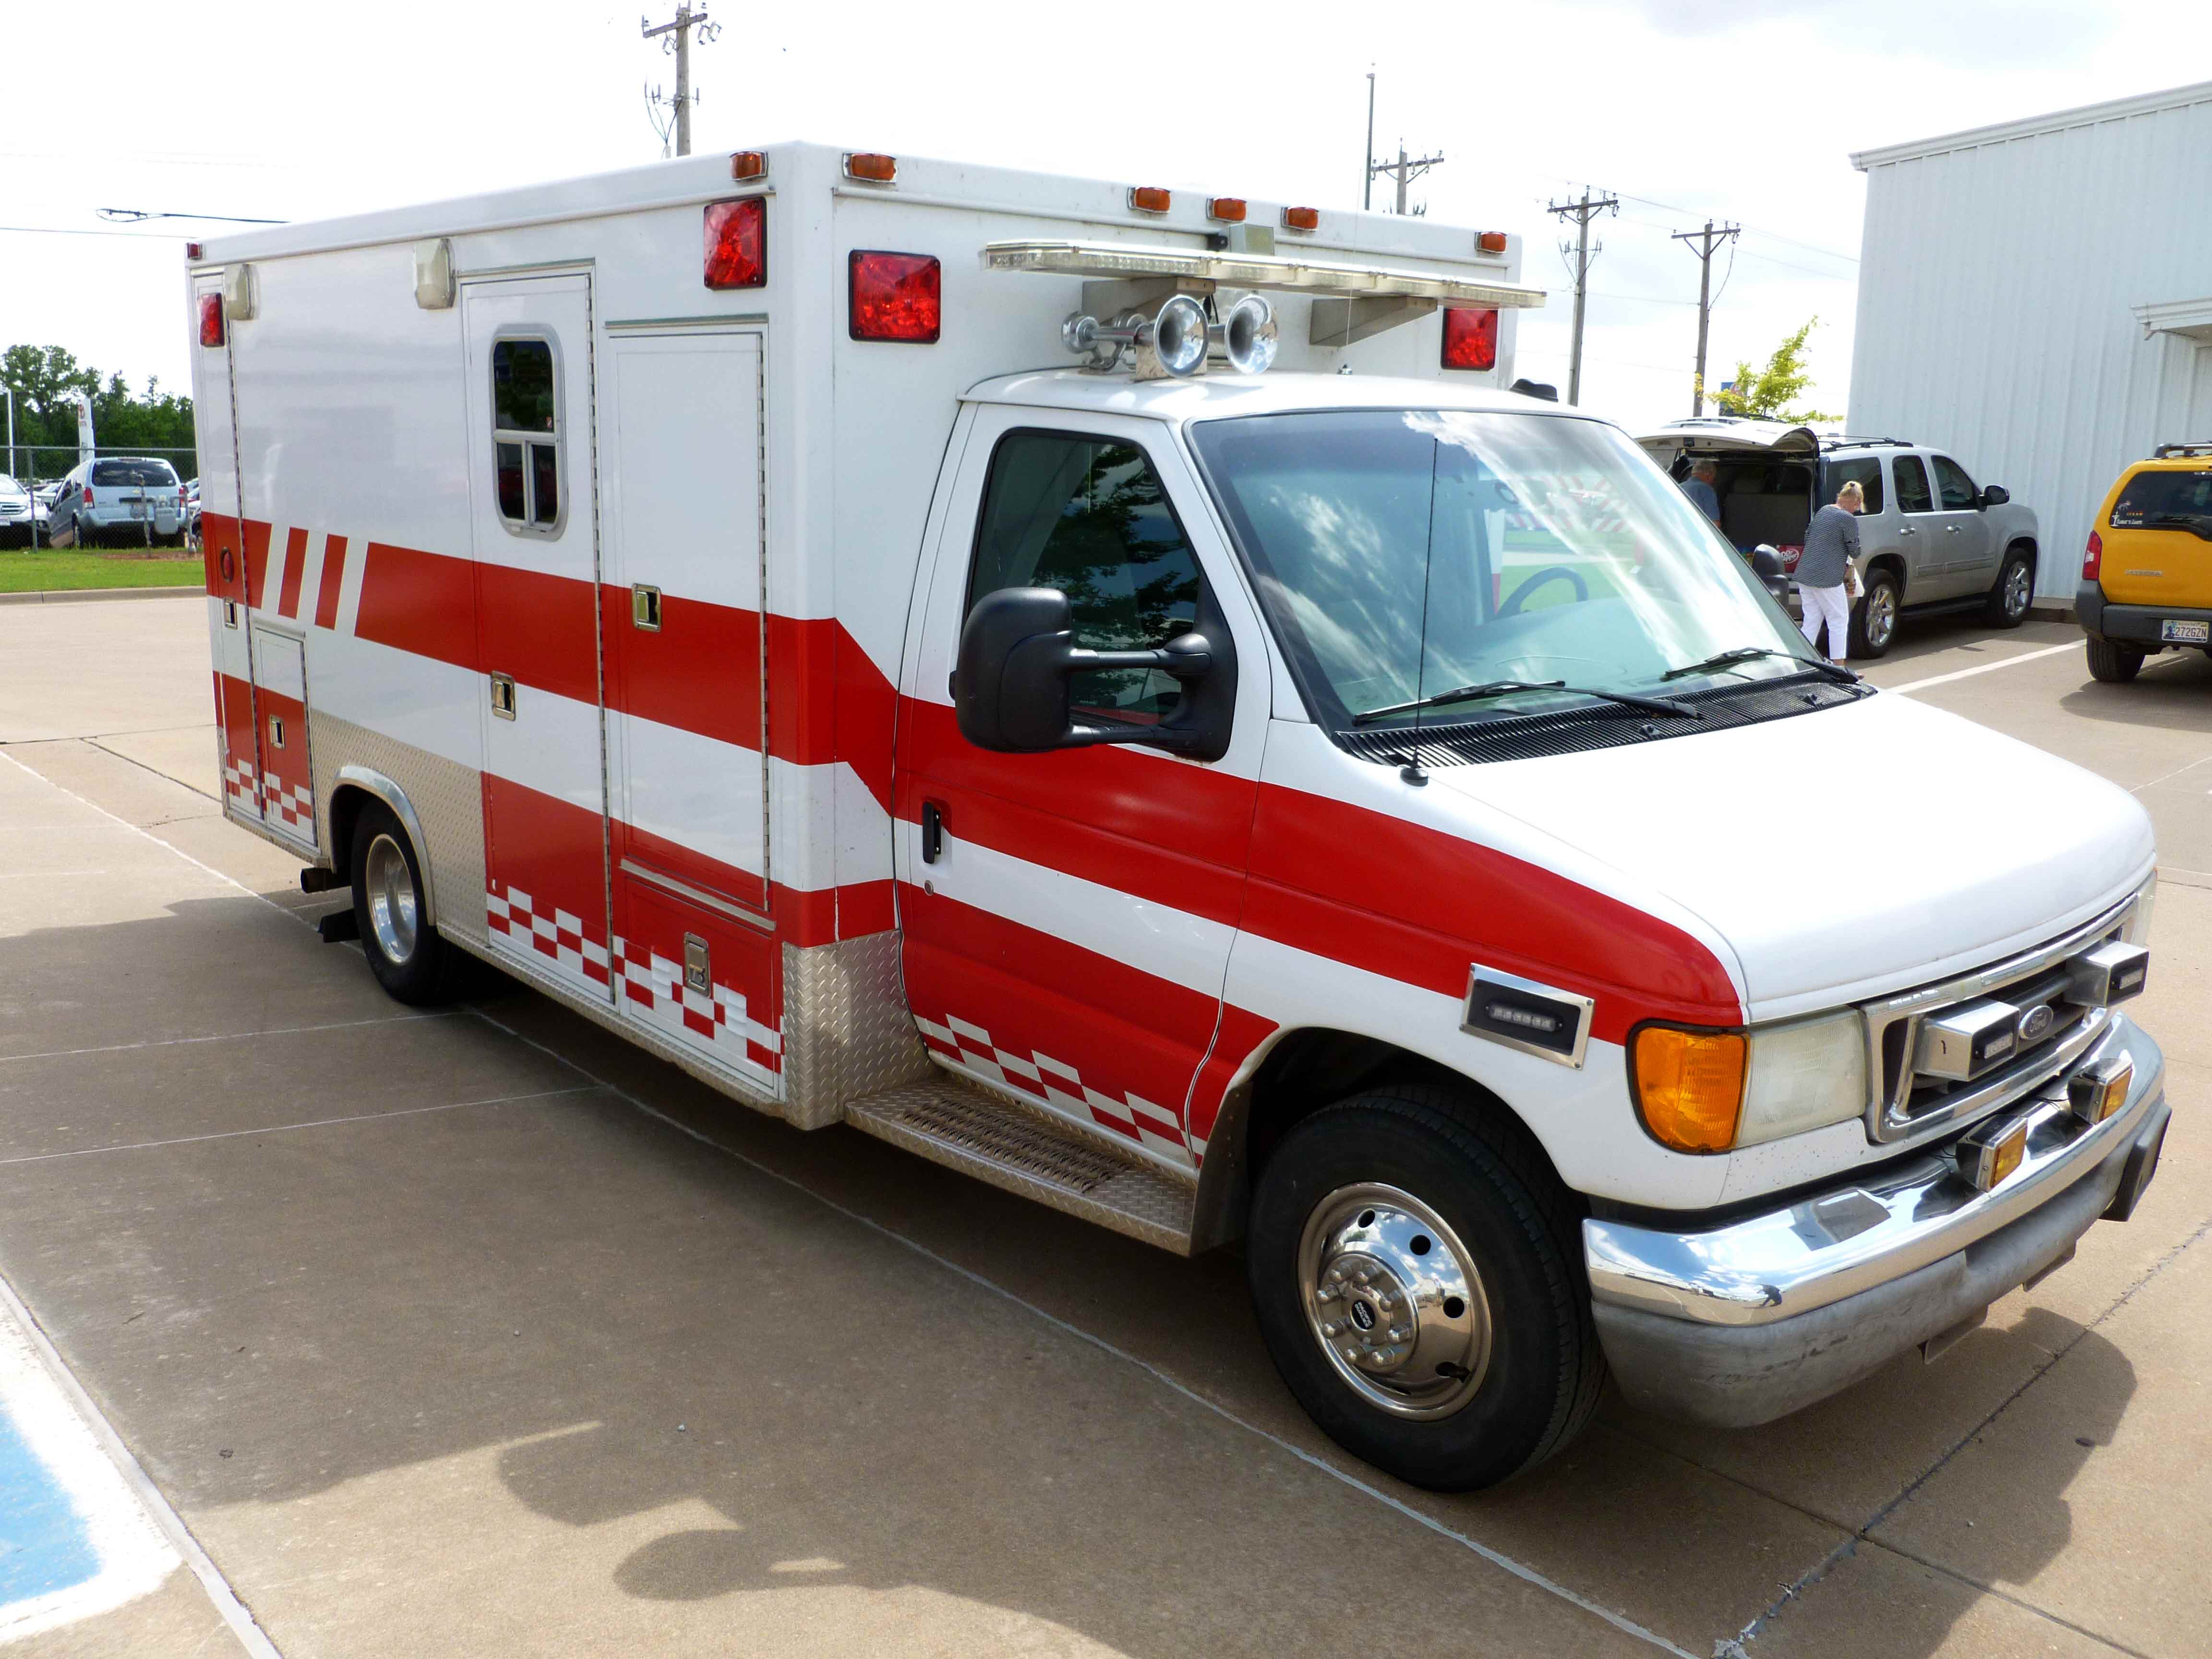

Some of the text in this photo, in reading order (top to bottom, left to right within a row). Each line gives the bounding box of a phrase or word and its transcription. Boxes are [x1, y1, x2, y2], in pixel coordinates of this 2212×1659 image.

[2175, 627, 2206, 637] 272GZN
[2030, 1012, 2047, 1033] Ford
[1358, 1302, 1372, 1325] PACIFIC
